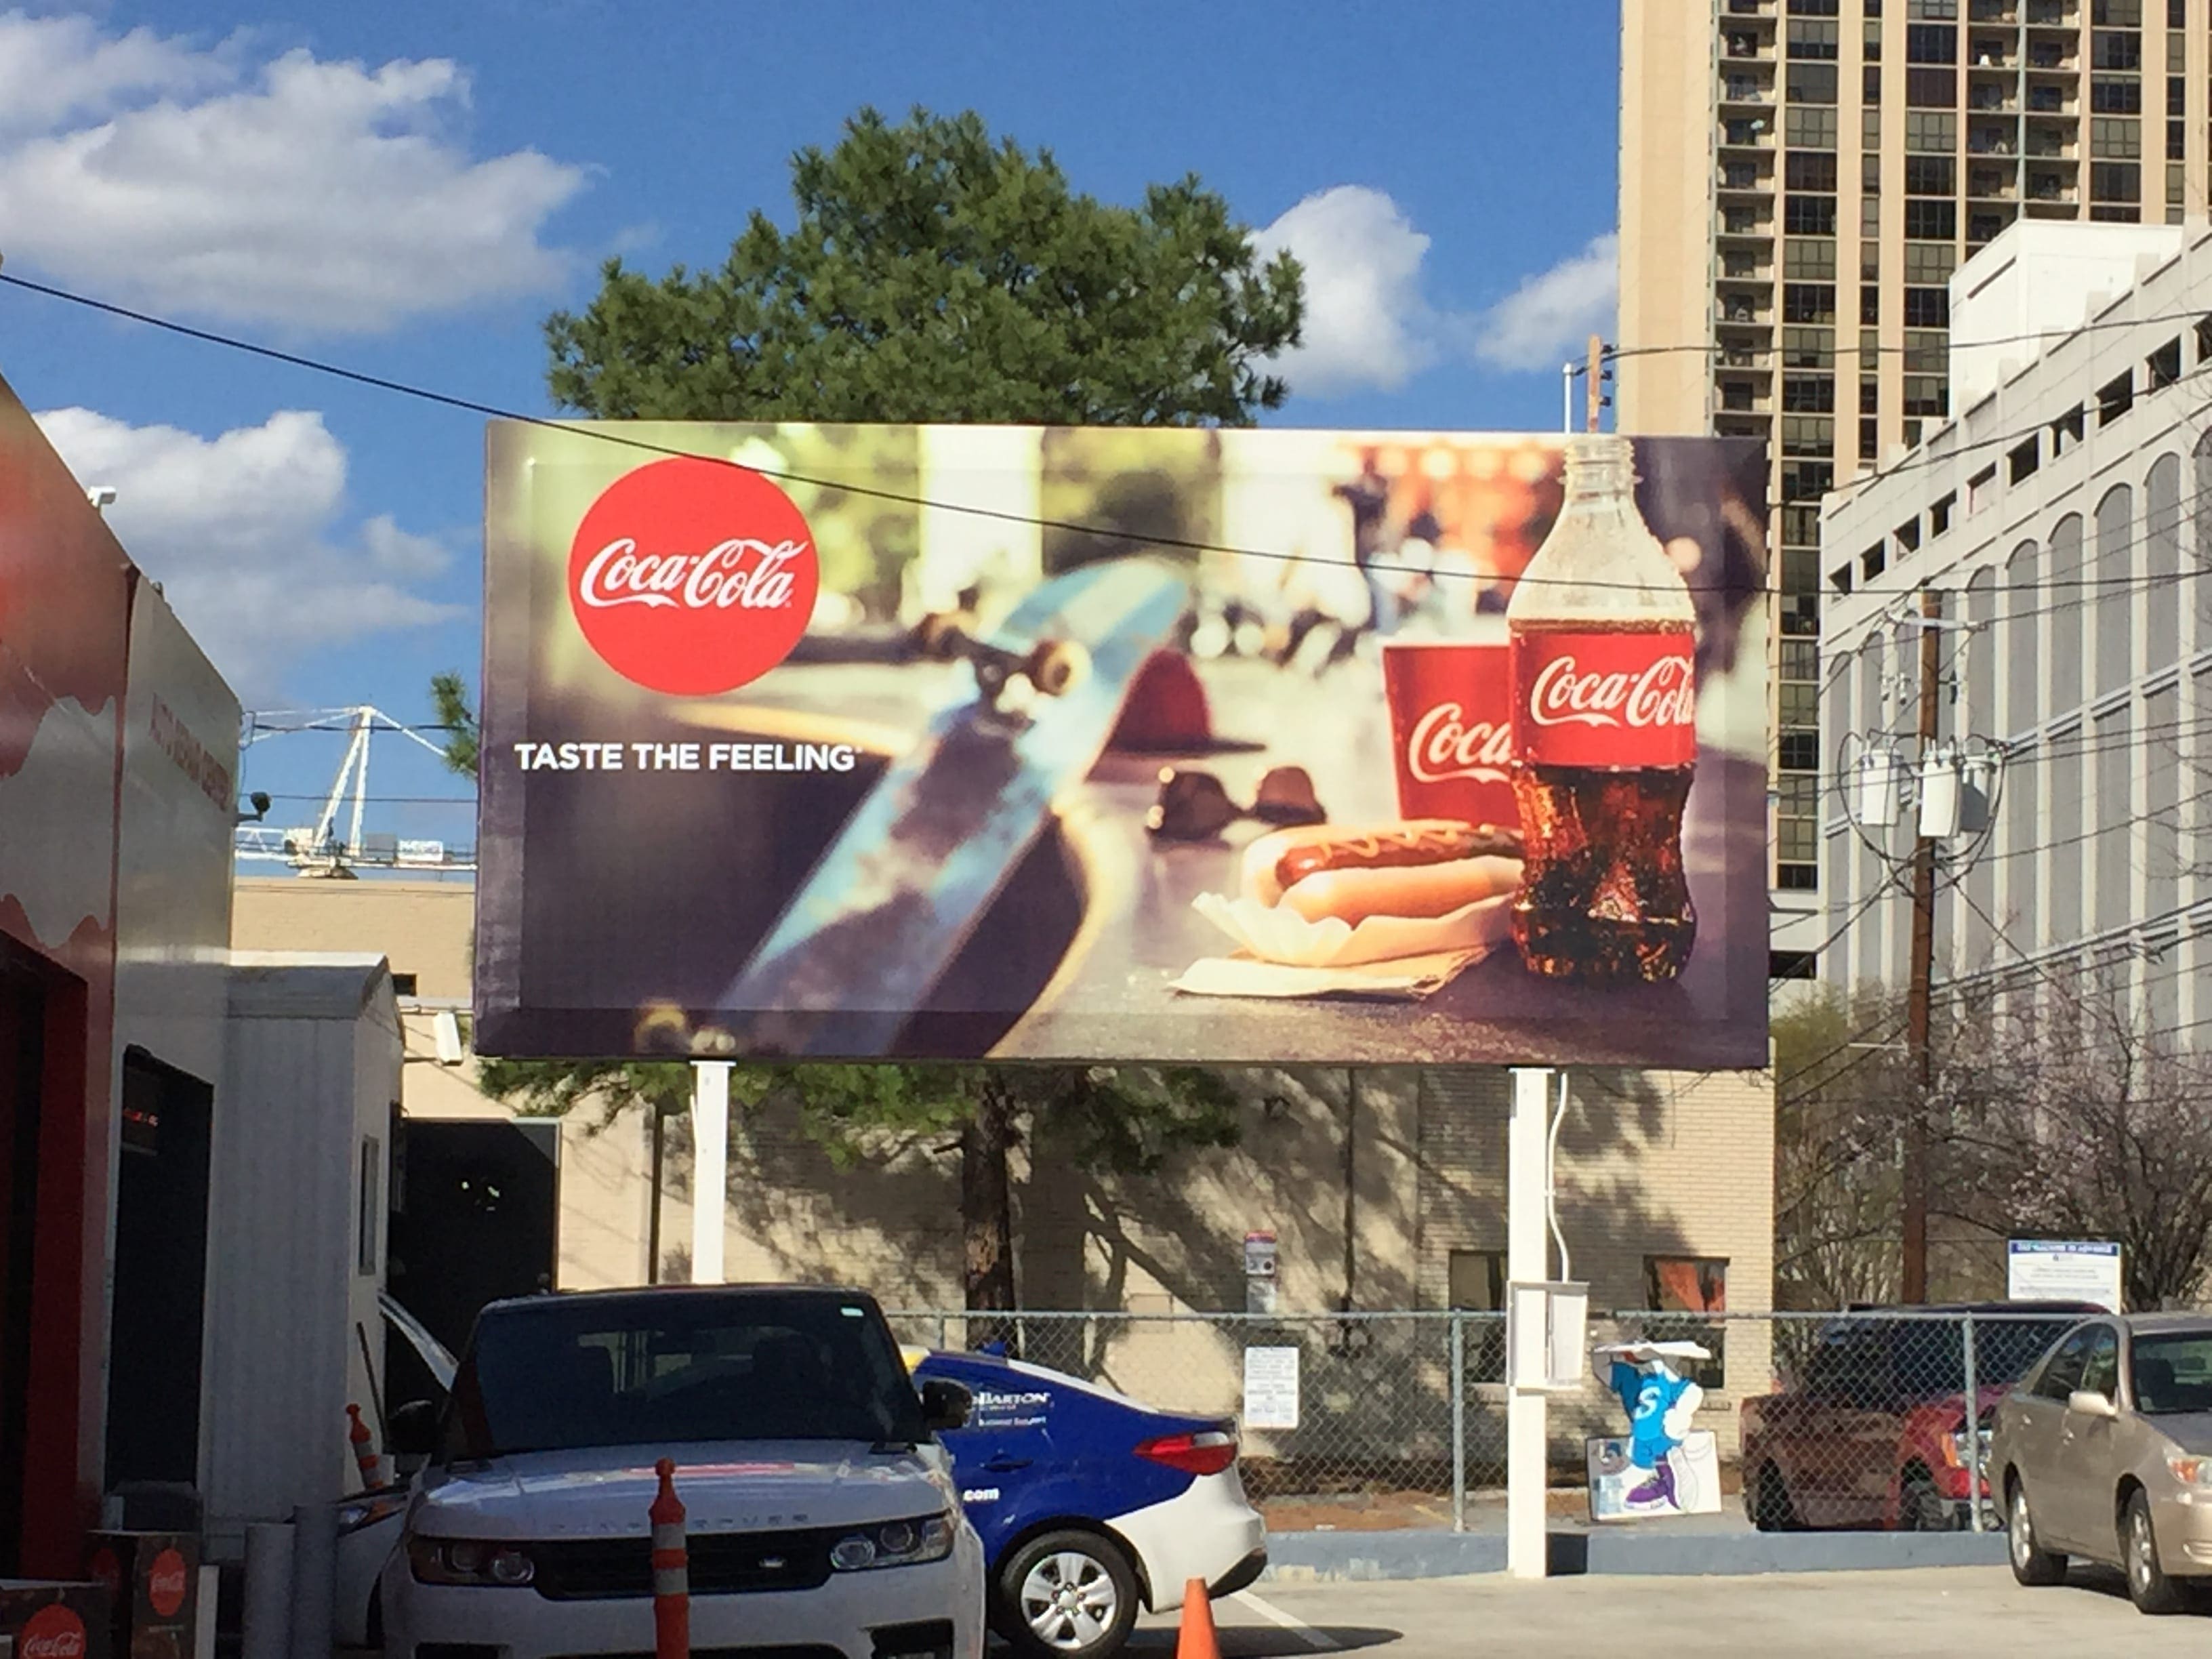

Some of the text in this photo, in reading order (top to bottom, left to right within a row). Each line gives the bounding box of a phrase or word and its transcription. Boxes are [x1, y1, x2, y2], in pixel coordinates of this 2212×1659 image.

[580, 538, 809, 609] Coca-Cola
[514, 743, 856, 772] TASTE THE FEELING
